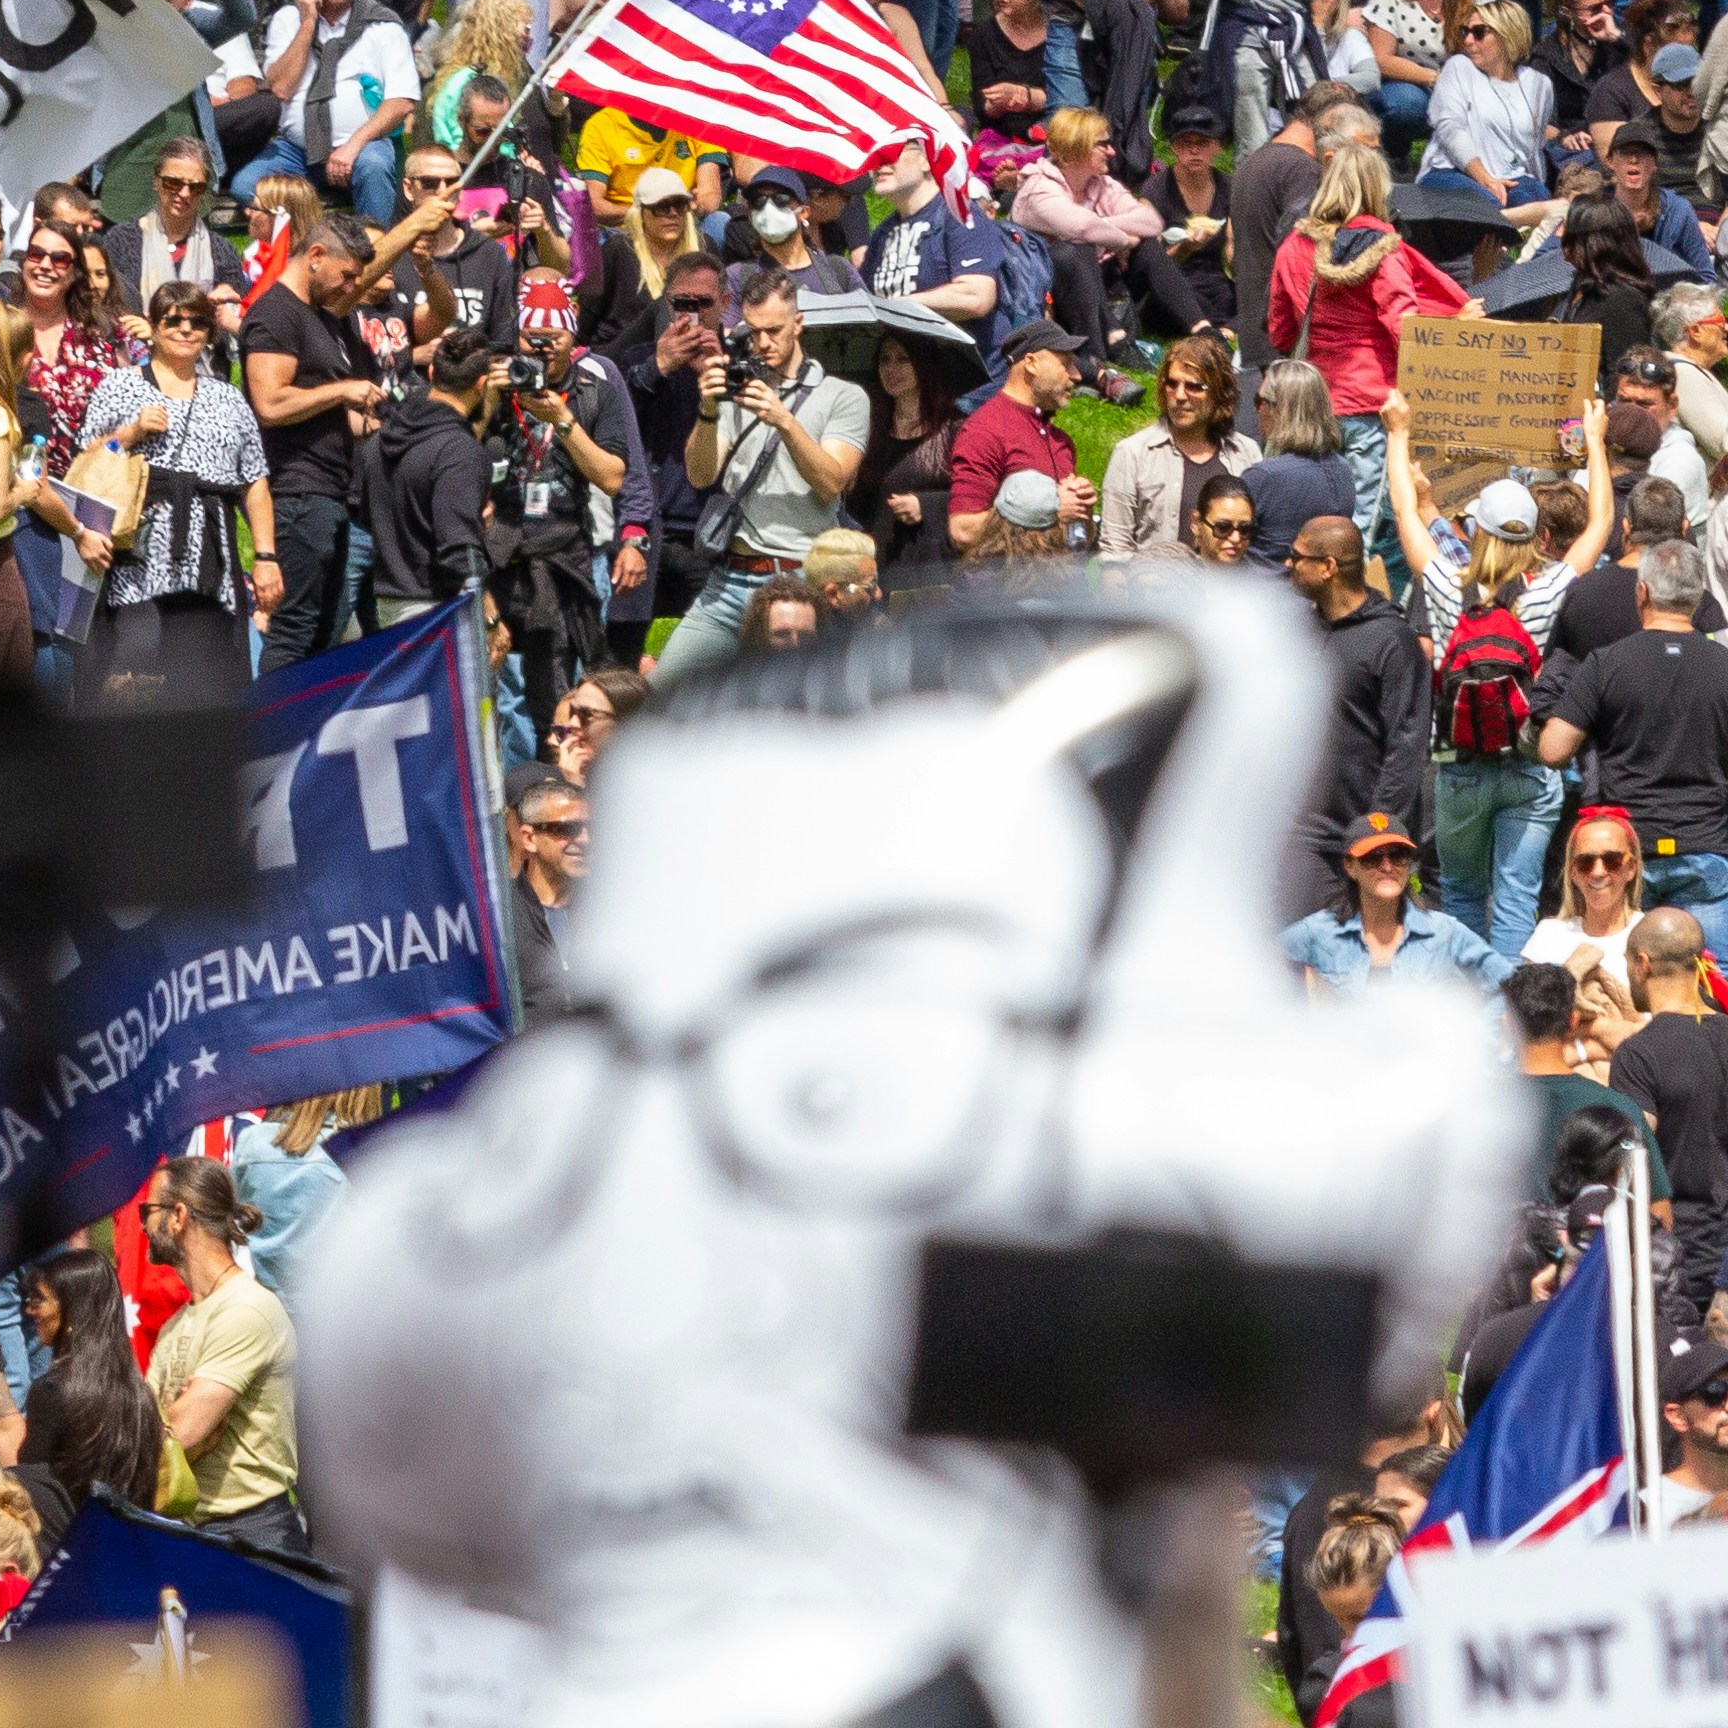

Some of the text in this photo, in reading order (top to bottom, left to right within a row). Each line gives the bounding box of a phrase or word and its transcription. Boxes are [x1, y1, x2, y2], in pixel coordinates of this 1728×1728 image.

[1414, 327, 1444, 347] WE
[1456, 331, 1495, 350] SAY
[1501, 334, 1527, 351] NO
[1422, 367, 1578, 388] VACCINE MANDATES
[1415, 388, 1568, 406] VACCINE PASSPORTS
[1459, 1616, 1623, 1709] NOT
